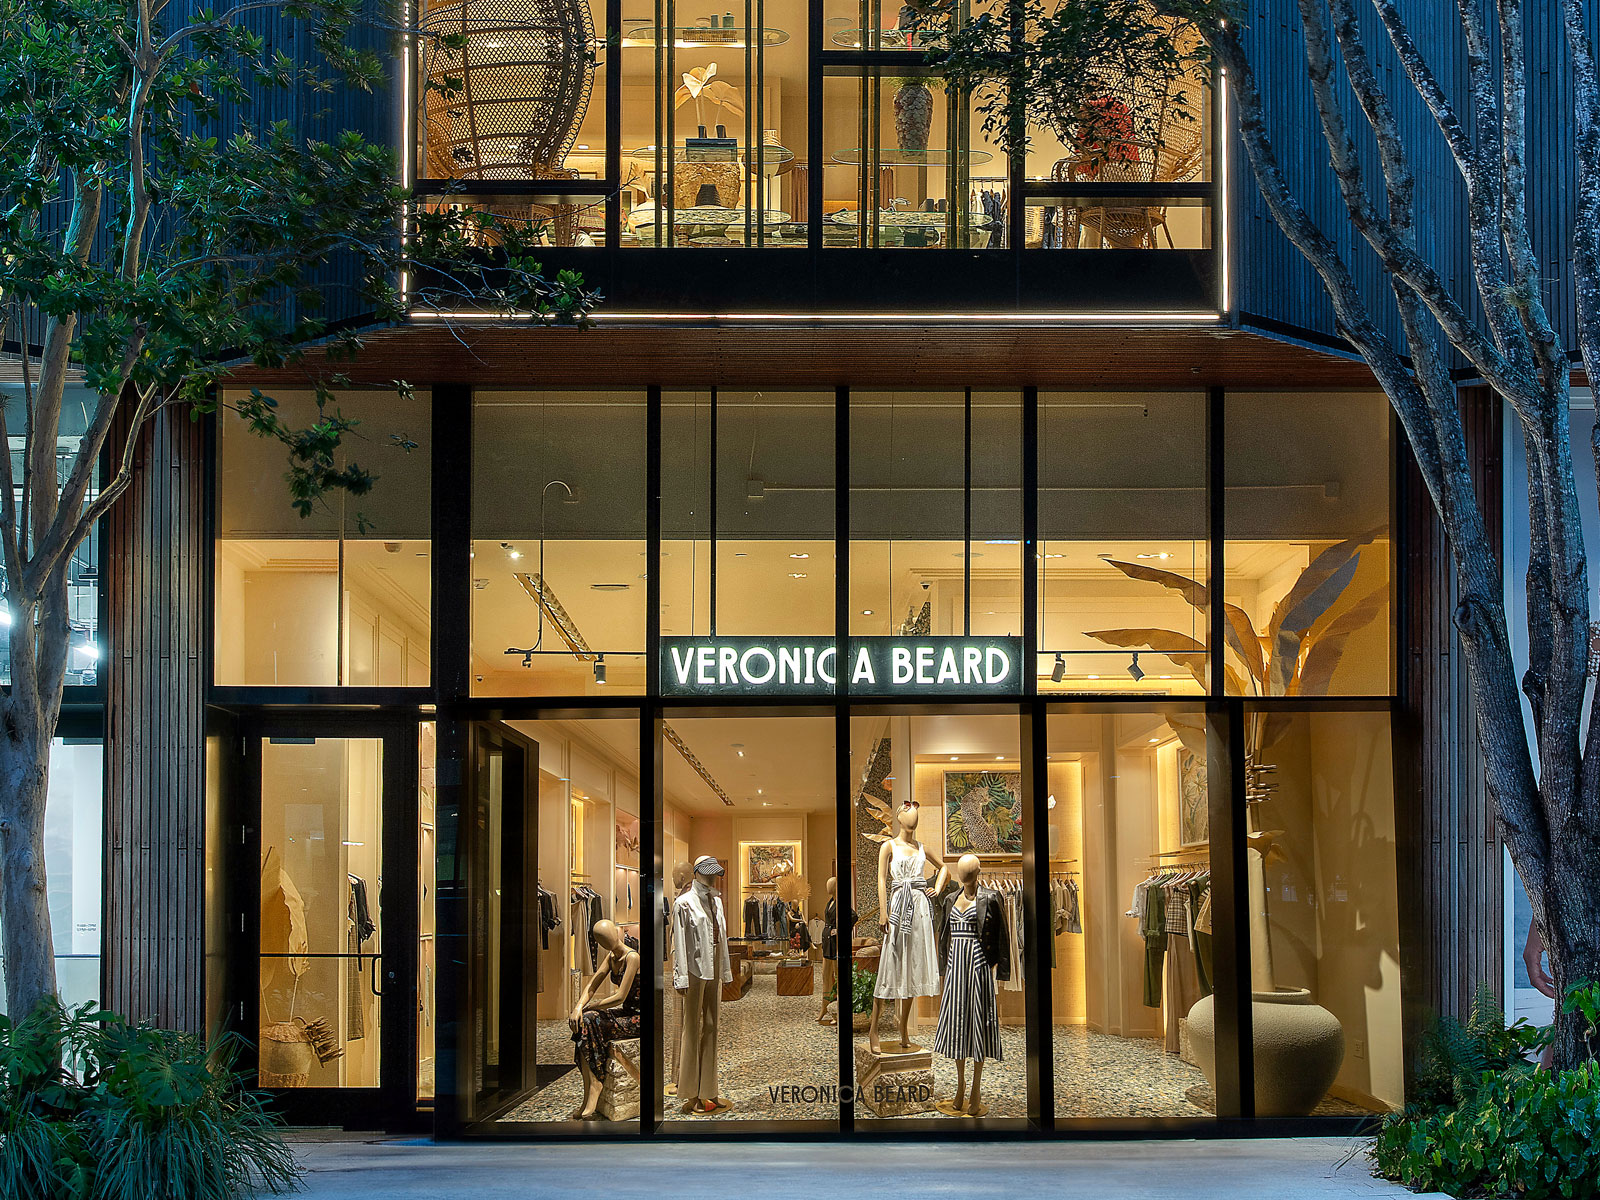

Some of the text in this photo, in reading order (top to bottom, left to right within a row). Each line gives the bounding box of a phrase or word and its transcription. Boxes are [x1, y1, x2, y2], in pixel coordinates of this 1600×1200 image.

[670, 646, 1010, 685] VERONICA BEARD
[768, 1084, 931, 1104] VERONICA BEARD
